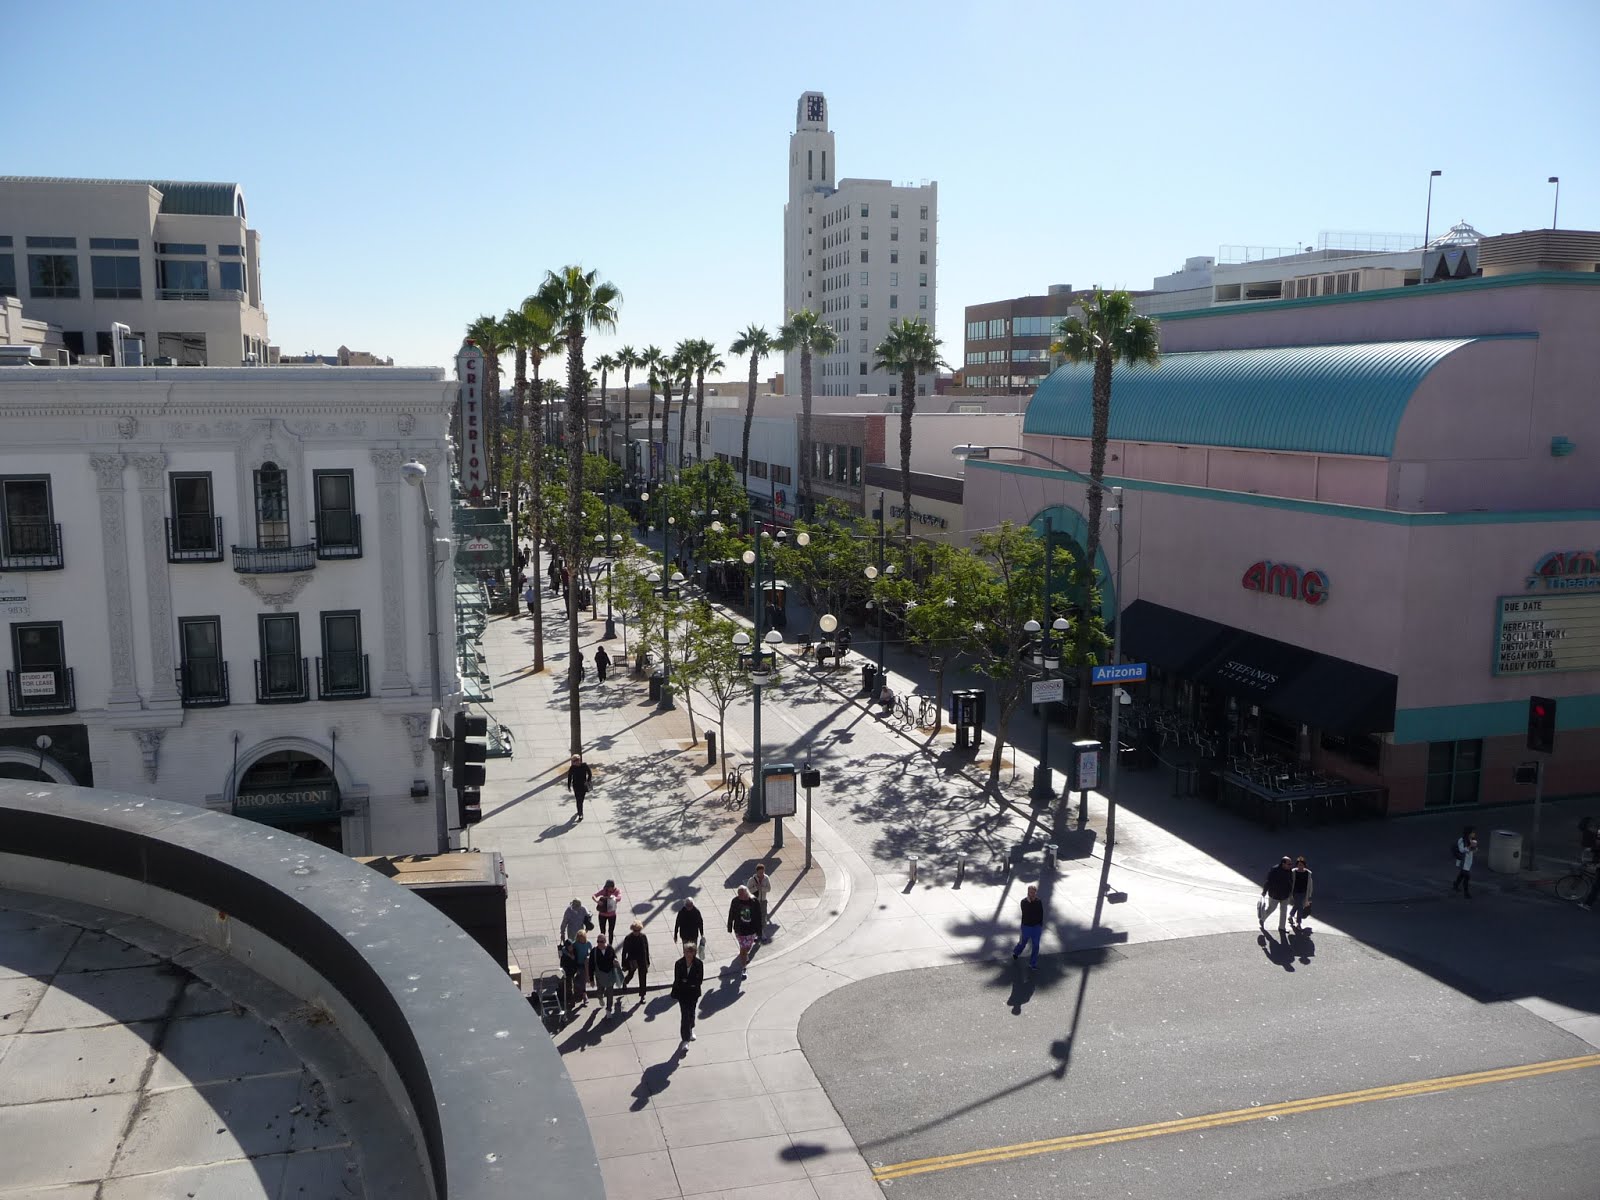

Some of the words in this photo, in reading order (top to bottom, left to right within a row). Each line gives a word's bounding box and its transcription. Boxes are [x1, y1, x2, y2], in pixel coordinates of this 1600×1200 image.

[466, 359, 480, 481] CRITERION
[1504, 602, 1520, 612] DUE
[1523, 601, 1542, 611] DATE
[1502, 621, 1544, 632] HEREAFTER
[1502, 633, 1529, 642] SOCIAL
[1532, 630, 1567, 640] NETWORK
[1501, 640, 1553, 651] UNSTOPPABLE
[1500, 651, 1539, 661] MEGAMIND
[1543, 650, 1553, 659] 3D
[1097, 667, 1143, 679] Arizona
